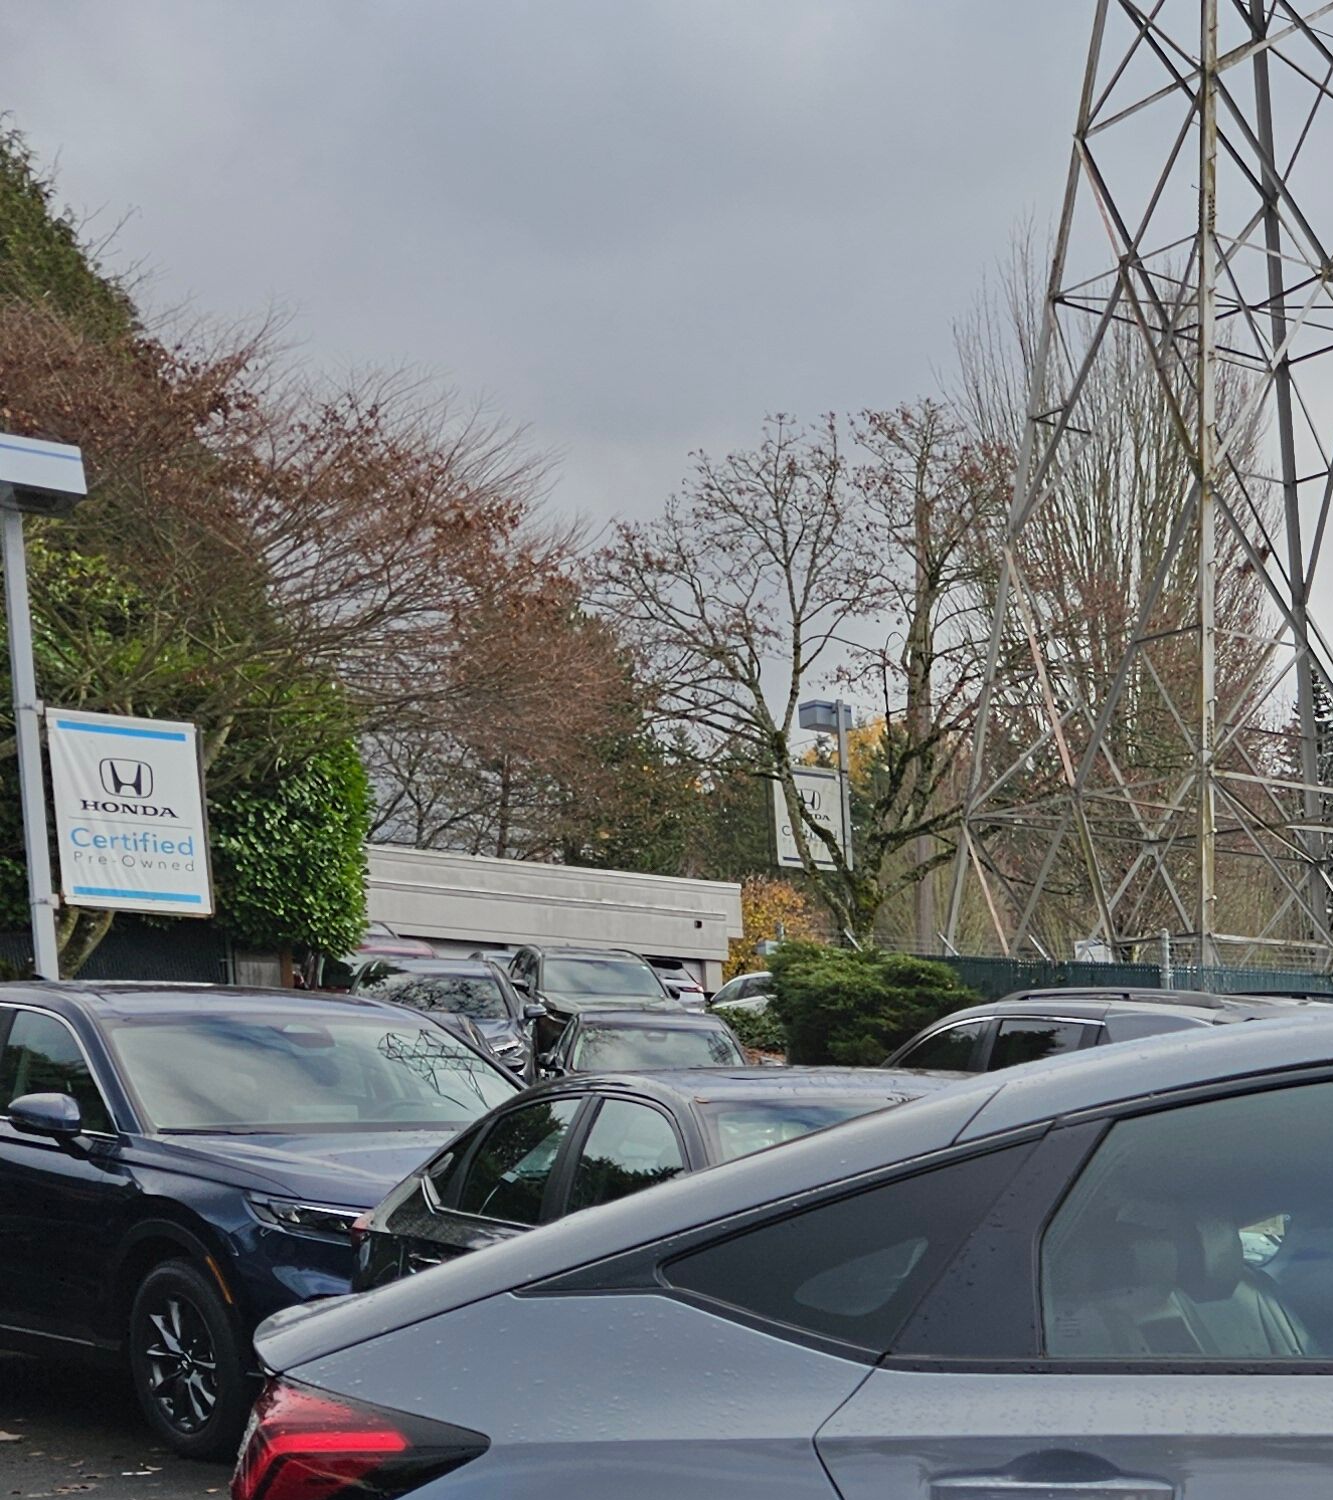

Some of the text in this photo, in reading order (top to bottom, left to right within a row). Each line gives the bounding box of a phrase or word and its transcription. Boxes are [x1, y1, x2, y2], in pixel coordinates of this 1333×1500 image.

[80, 799, 179, 818] HONDA
[70, 827, 194, 856] Certified
[73, 851, 194, 872] Pre-Owned
